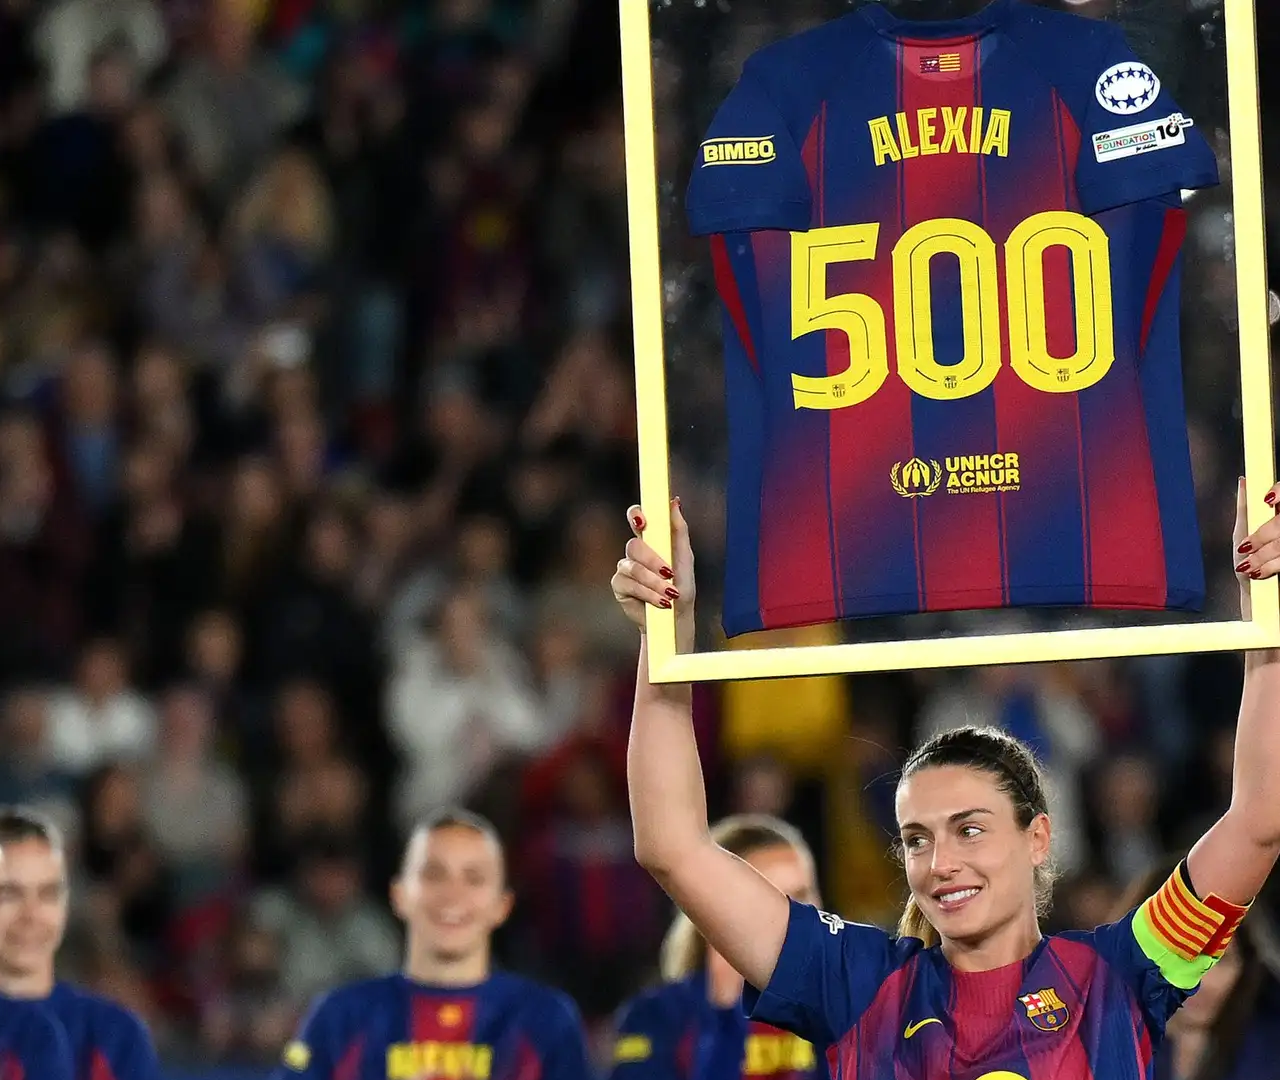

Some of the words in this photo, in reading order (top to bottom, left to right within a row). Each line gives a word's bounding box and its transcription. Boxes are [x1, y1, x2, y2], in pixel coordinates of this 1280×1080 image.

[868, 107, 1011, 166] ALEXIA
[1096, 132, 1156, 152] FOUNDATION
[1156, 124, 1180, 140] 10
[703, 140, 775, 163] BIMBO
[790, 211, 1115, 411] 500
[945, 453, 1019, 472] UNHCR
[946, 469, 1020, 488] ACNUR
